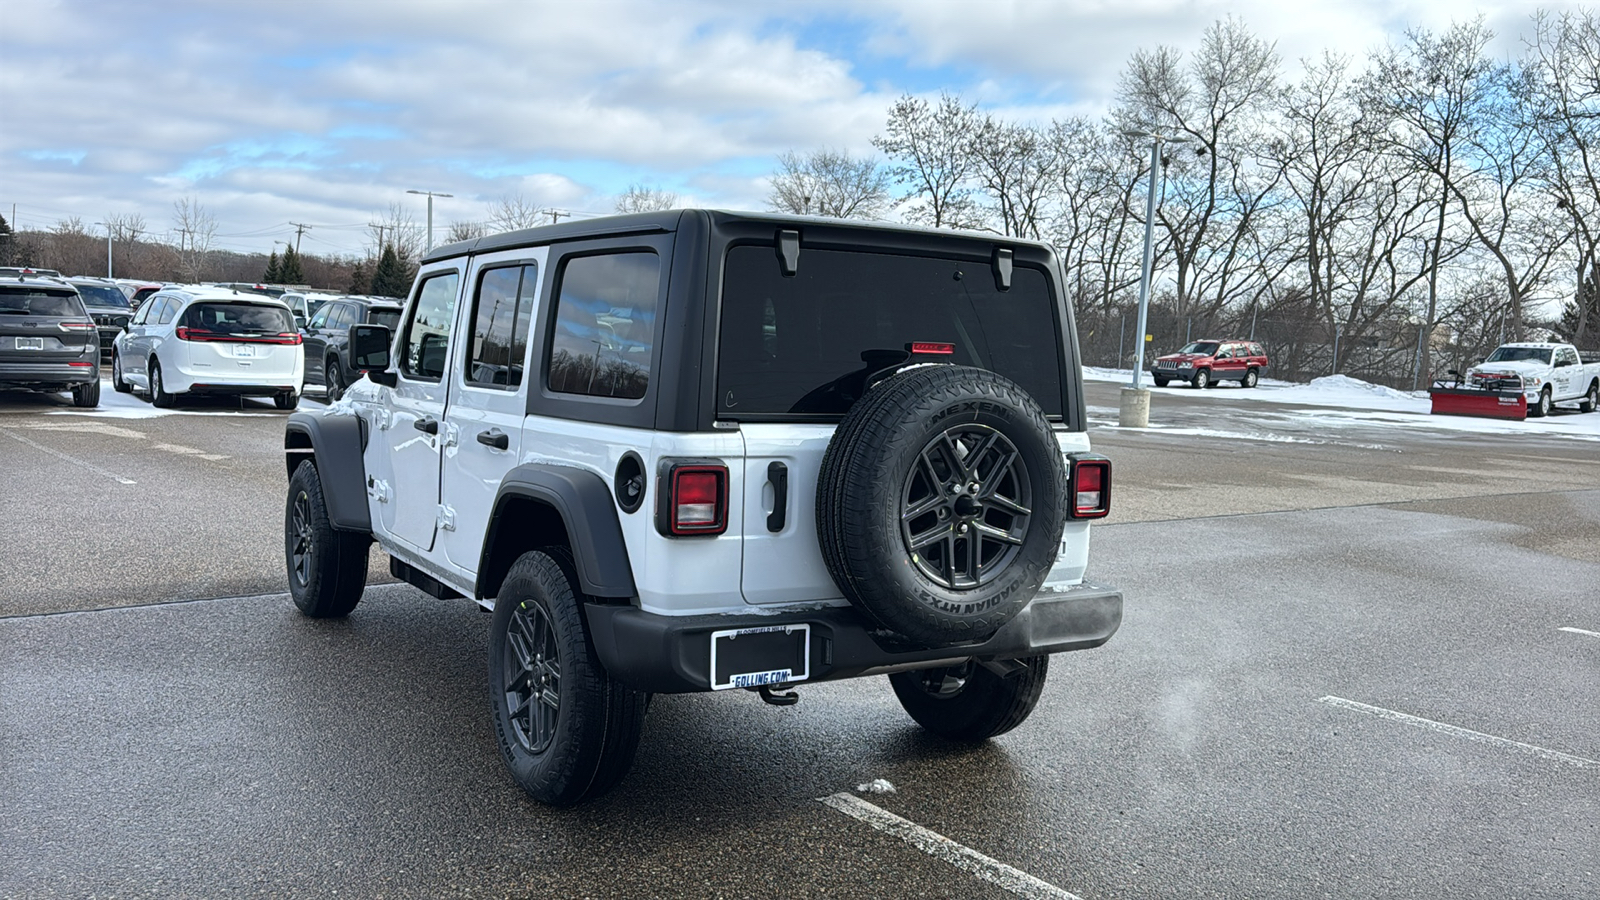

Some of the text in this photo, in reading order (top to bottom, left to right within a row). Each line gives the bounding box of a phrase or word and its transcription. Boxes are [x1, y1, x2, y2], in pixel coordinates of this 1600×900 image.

[931, 402, 1008, 423] NEXEN
[918, 568, 1028, 614] ROADIAN HTX2
[735, 671, 788, 688] GOLLING.COM
[494, 701, 515, 762] ROADIAN
